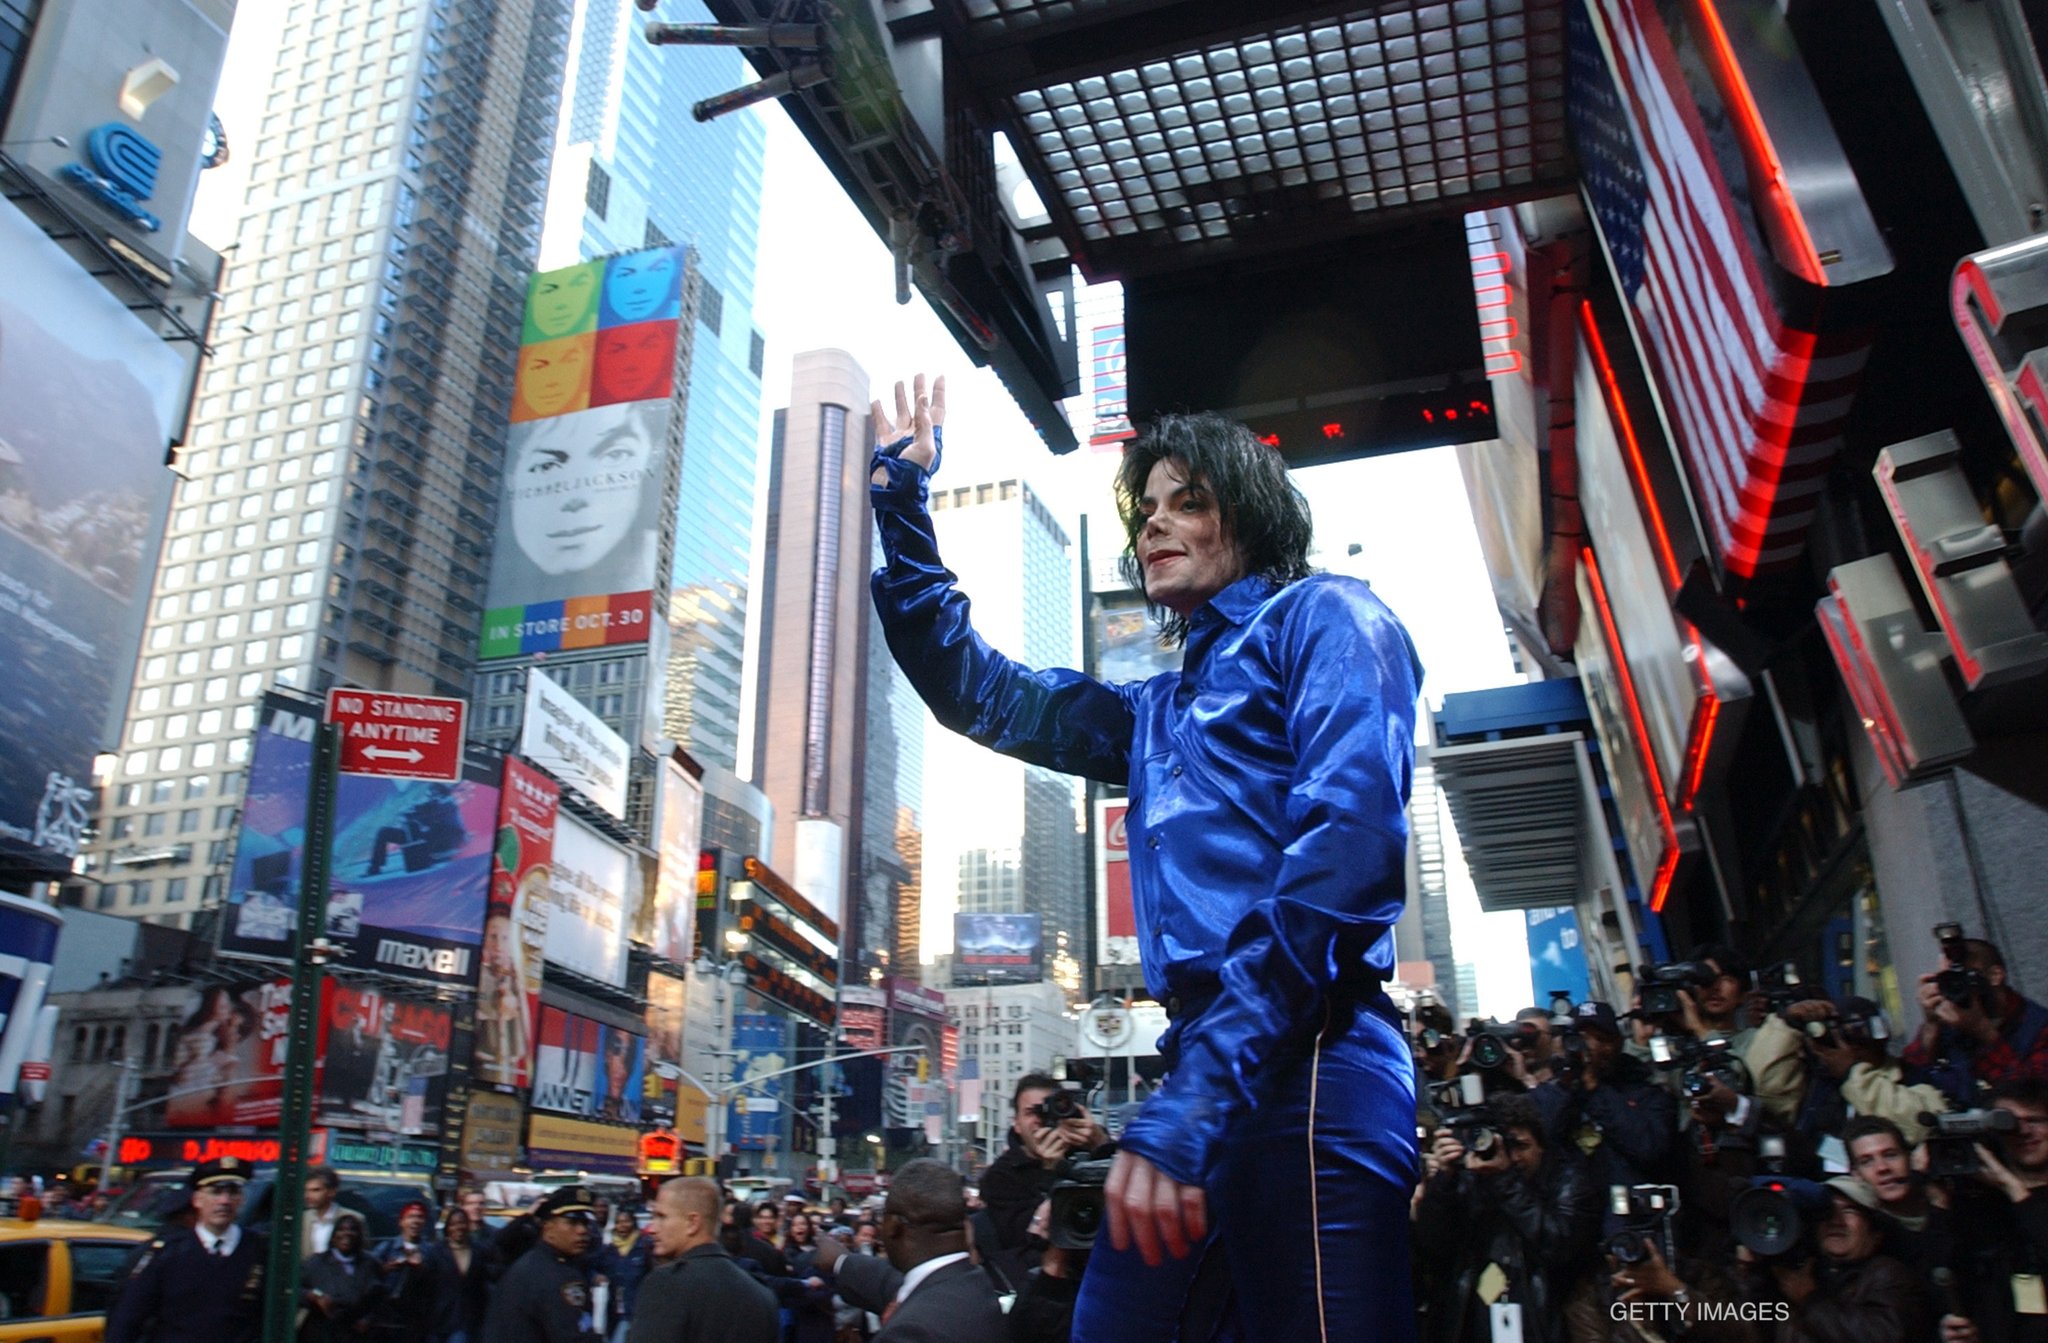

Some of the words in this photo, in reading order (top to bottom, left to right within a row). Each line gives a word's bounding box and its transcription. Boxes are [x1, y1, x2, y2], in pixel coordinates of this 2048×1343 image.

[489, 625, 510, 641] IN
[513, 616, 571, 638] STORE
[574, 612, 616, 630] OCT.
[619, 608, 644, 626] 30
[337, 696, 364, 715] NO
[371, 699, 457, 723] STANDING
[349, 722, 440, 745] ANYTIME
[375, 938, 472, 977] maxell
